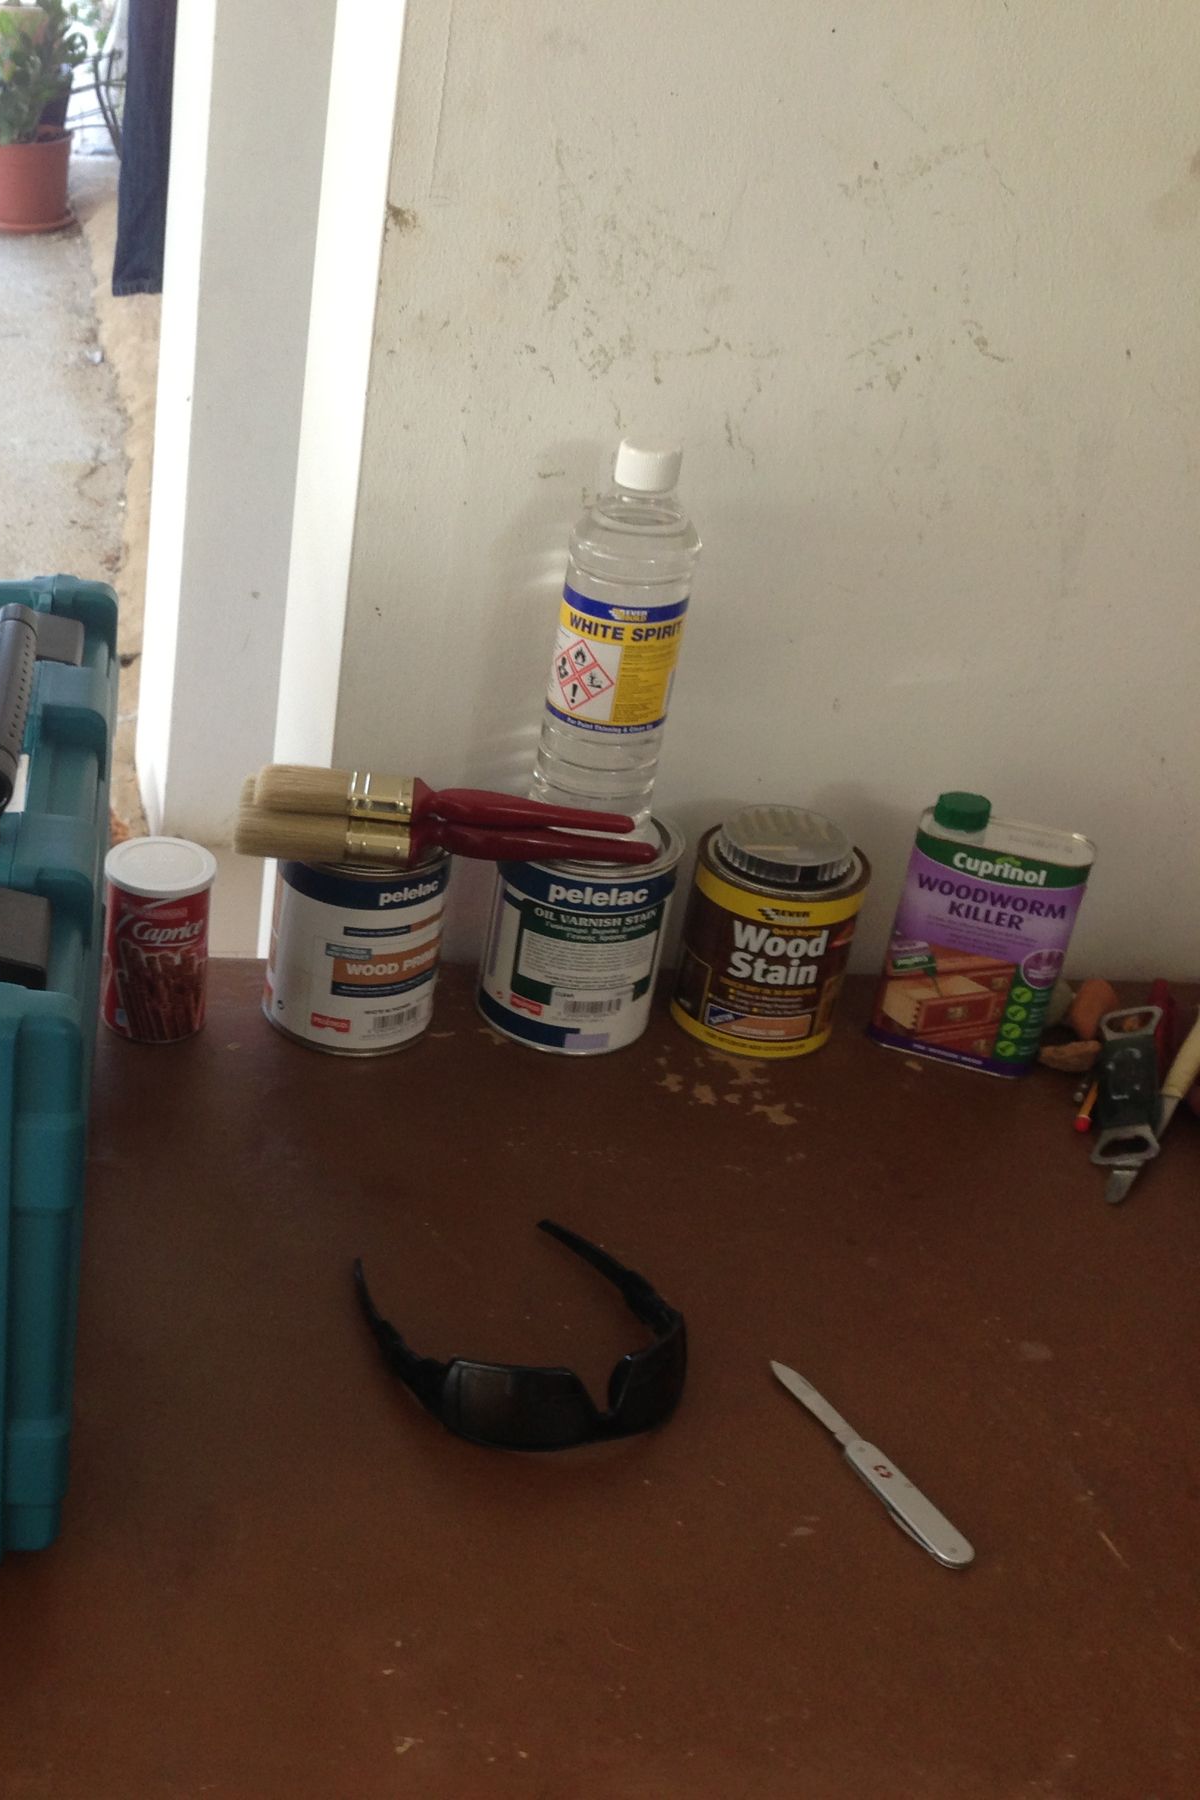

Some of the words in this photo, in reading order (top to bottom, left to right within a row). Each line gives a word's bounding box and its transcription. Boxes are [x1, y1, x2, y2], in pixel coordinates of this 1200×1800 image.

[569, 611, 626, 641] WHITE
[631, 619, 683, 642] SPIRIT
[952, 852, 1049, 886] Cuprinol
[379, 879, 439, 907] pelelac
[548, 883, 650, 907] pelelac
[917, 873, 1067, 920] WOODWORM
[534, 906, 558, 922] OIL
[560, 913, 623, 927] VARNISH
[625, 907, 658, 926] STAIN
[947, 902, 1025, 931] KILLER
[733, 919, 830, 958] Wood
[346, 962, 400, 977] WOOD
[726, 950, 819, 986] Stain
